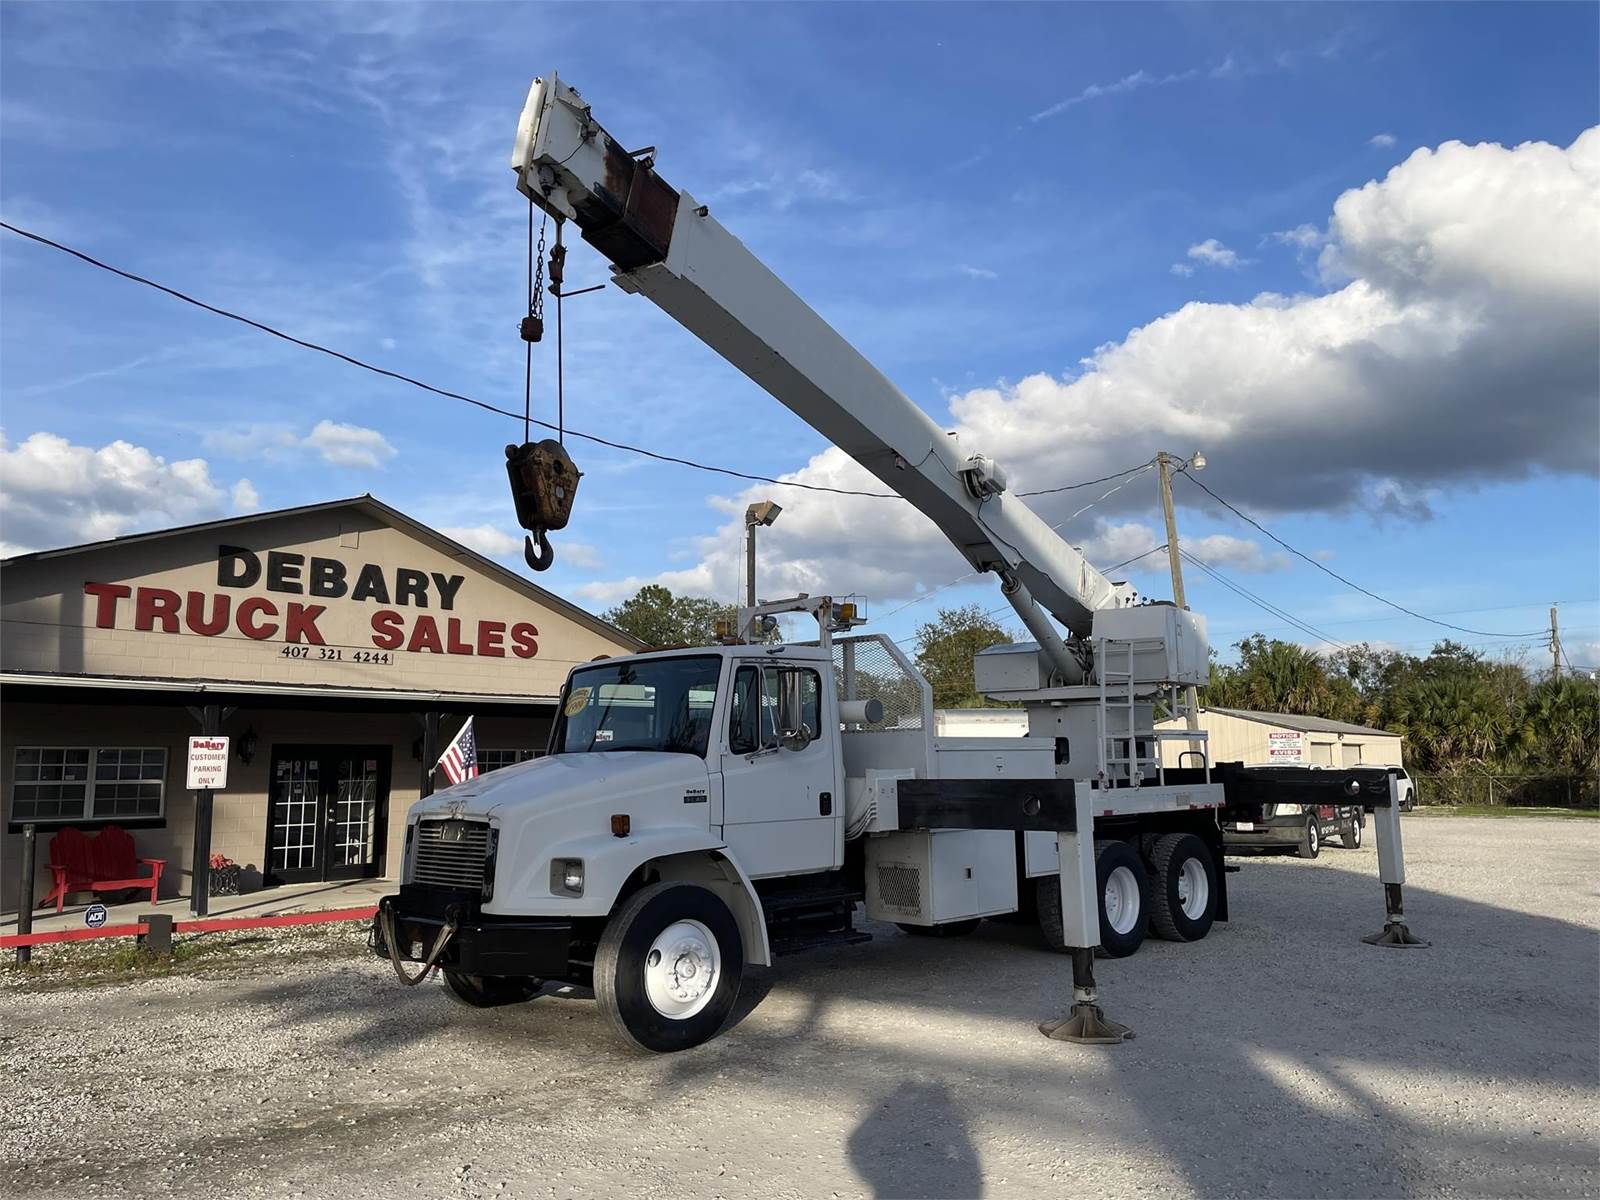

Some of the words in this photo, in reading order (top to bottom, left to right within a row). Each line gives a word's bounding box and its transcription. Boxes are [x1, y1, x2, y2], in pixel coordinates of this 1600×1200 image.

[217, 544, 465, 610] DEBARY
[84, 582, 327, 645] TRUCK
[371, 610, 539, 658] SALES
[282, 646, 309, 658] 407
[318, 648, 342, 660] 321
[353, 651, 389, 664] 4244
[88, 912, 104, 921] ADT
